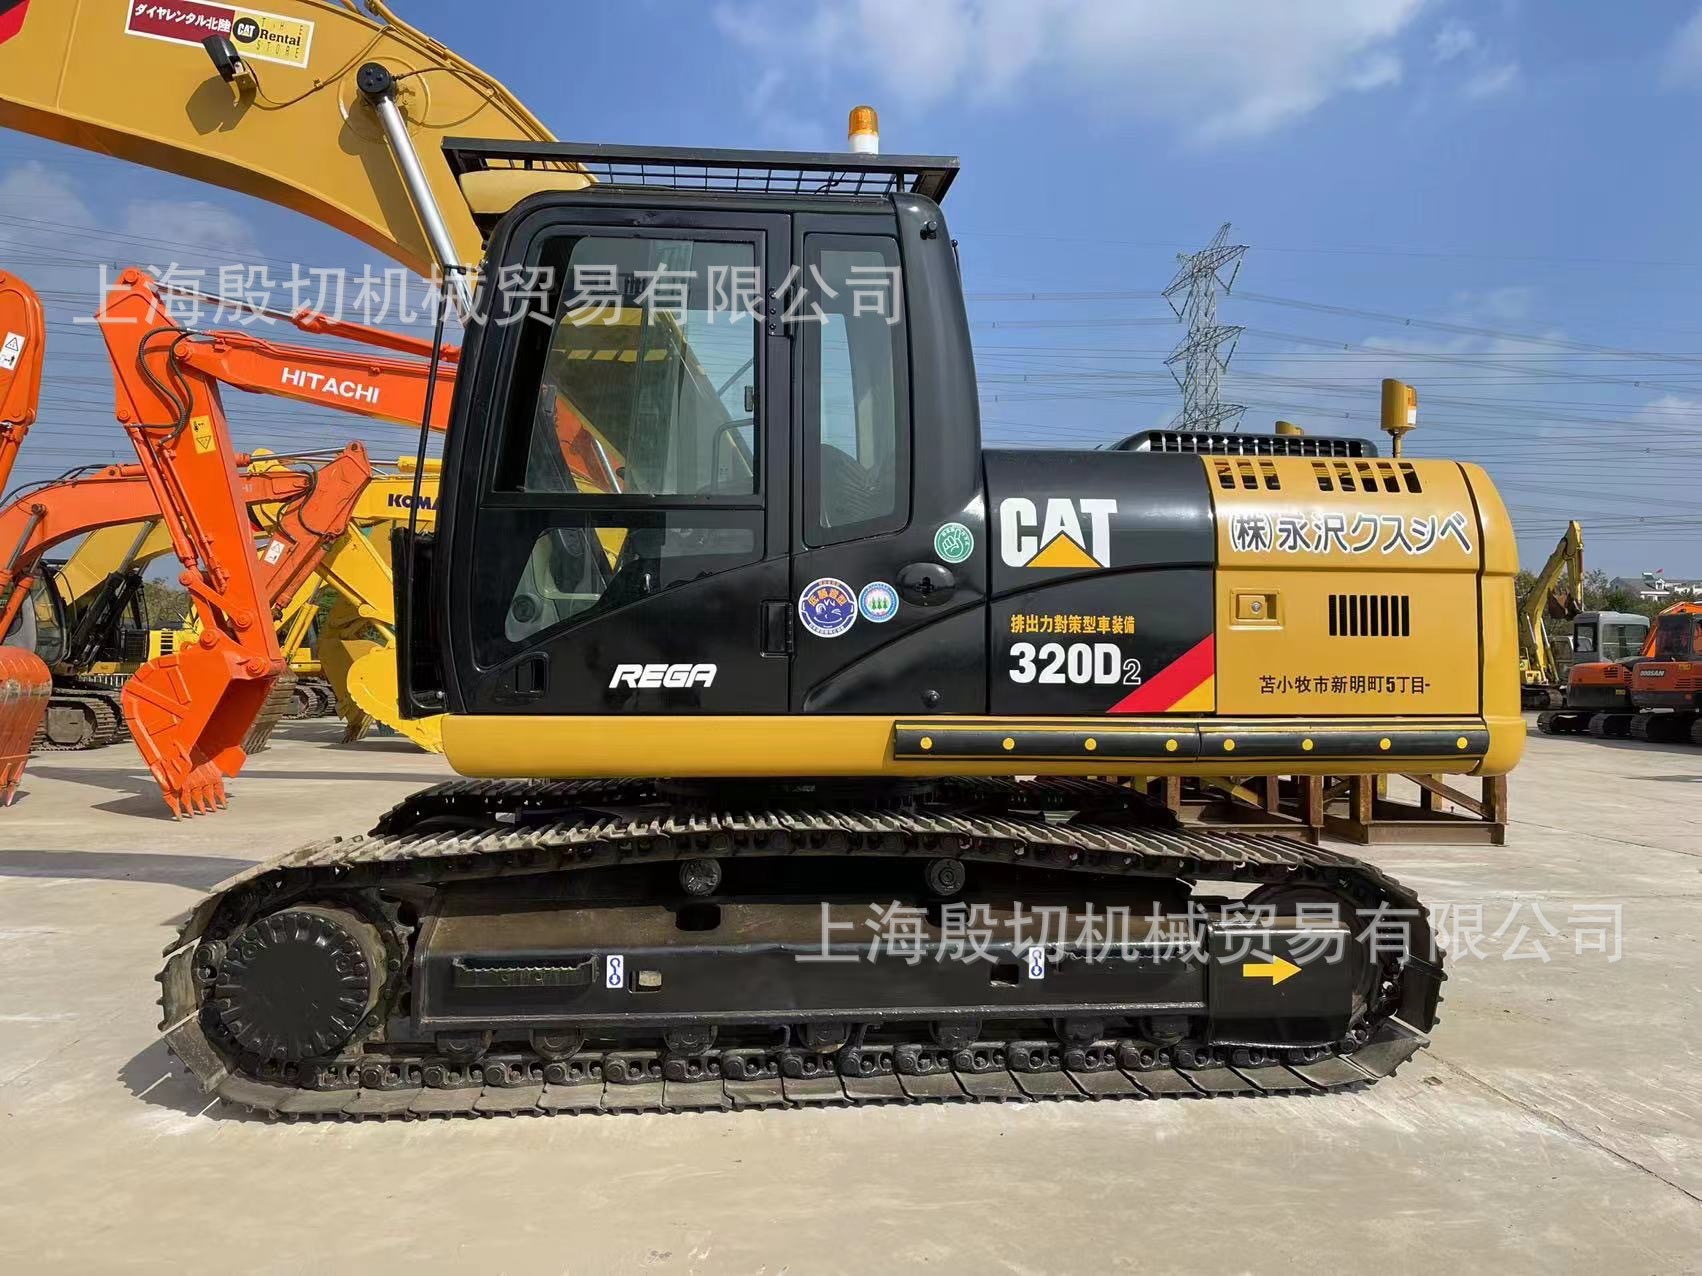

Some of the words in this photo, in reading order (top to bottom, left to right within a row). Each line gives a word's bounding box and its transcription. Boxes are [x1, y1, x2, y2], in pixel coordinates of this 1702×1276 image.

[134, 3, 232, 33] ダイヤレンタル北陸
[237, 23, 256, 38] CAT
[256, 40, 299, 58] STORE
[260, 29, 301, 46] Rental
[281, 367, 380, 404] HITACHI
[1000, 497, 1118, 568] CAT
[608, 663, 718, 689] REGA
[1009, 642, 1142, 685] 320D2
